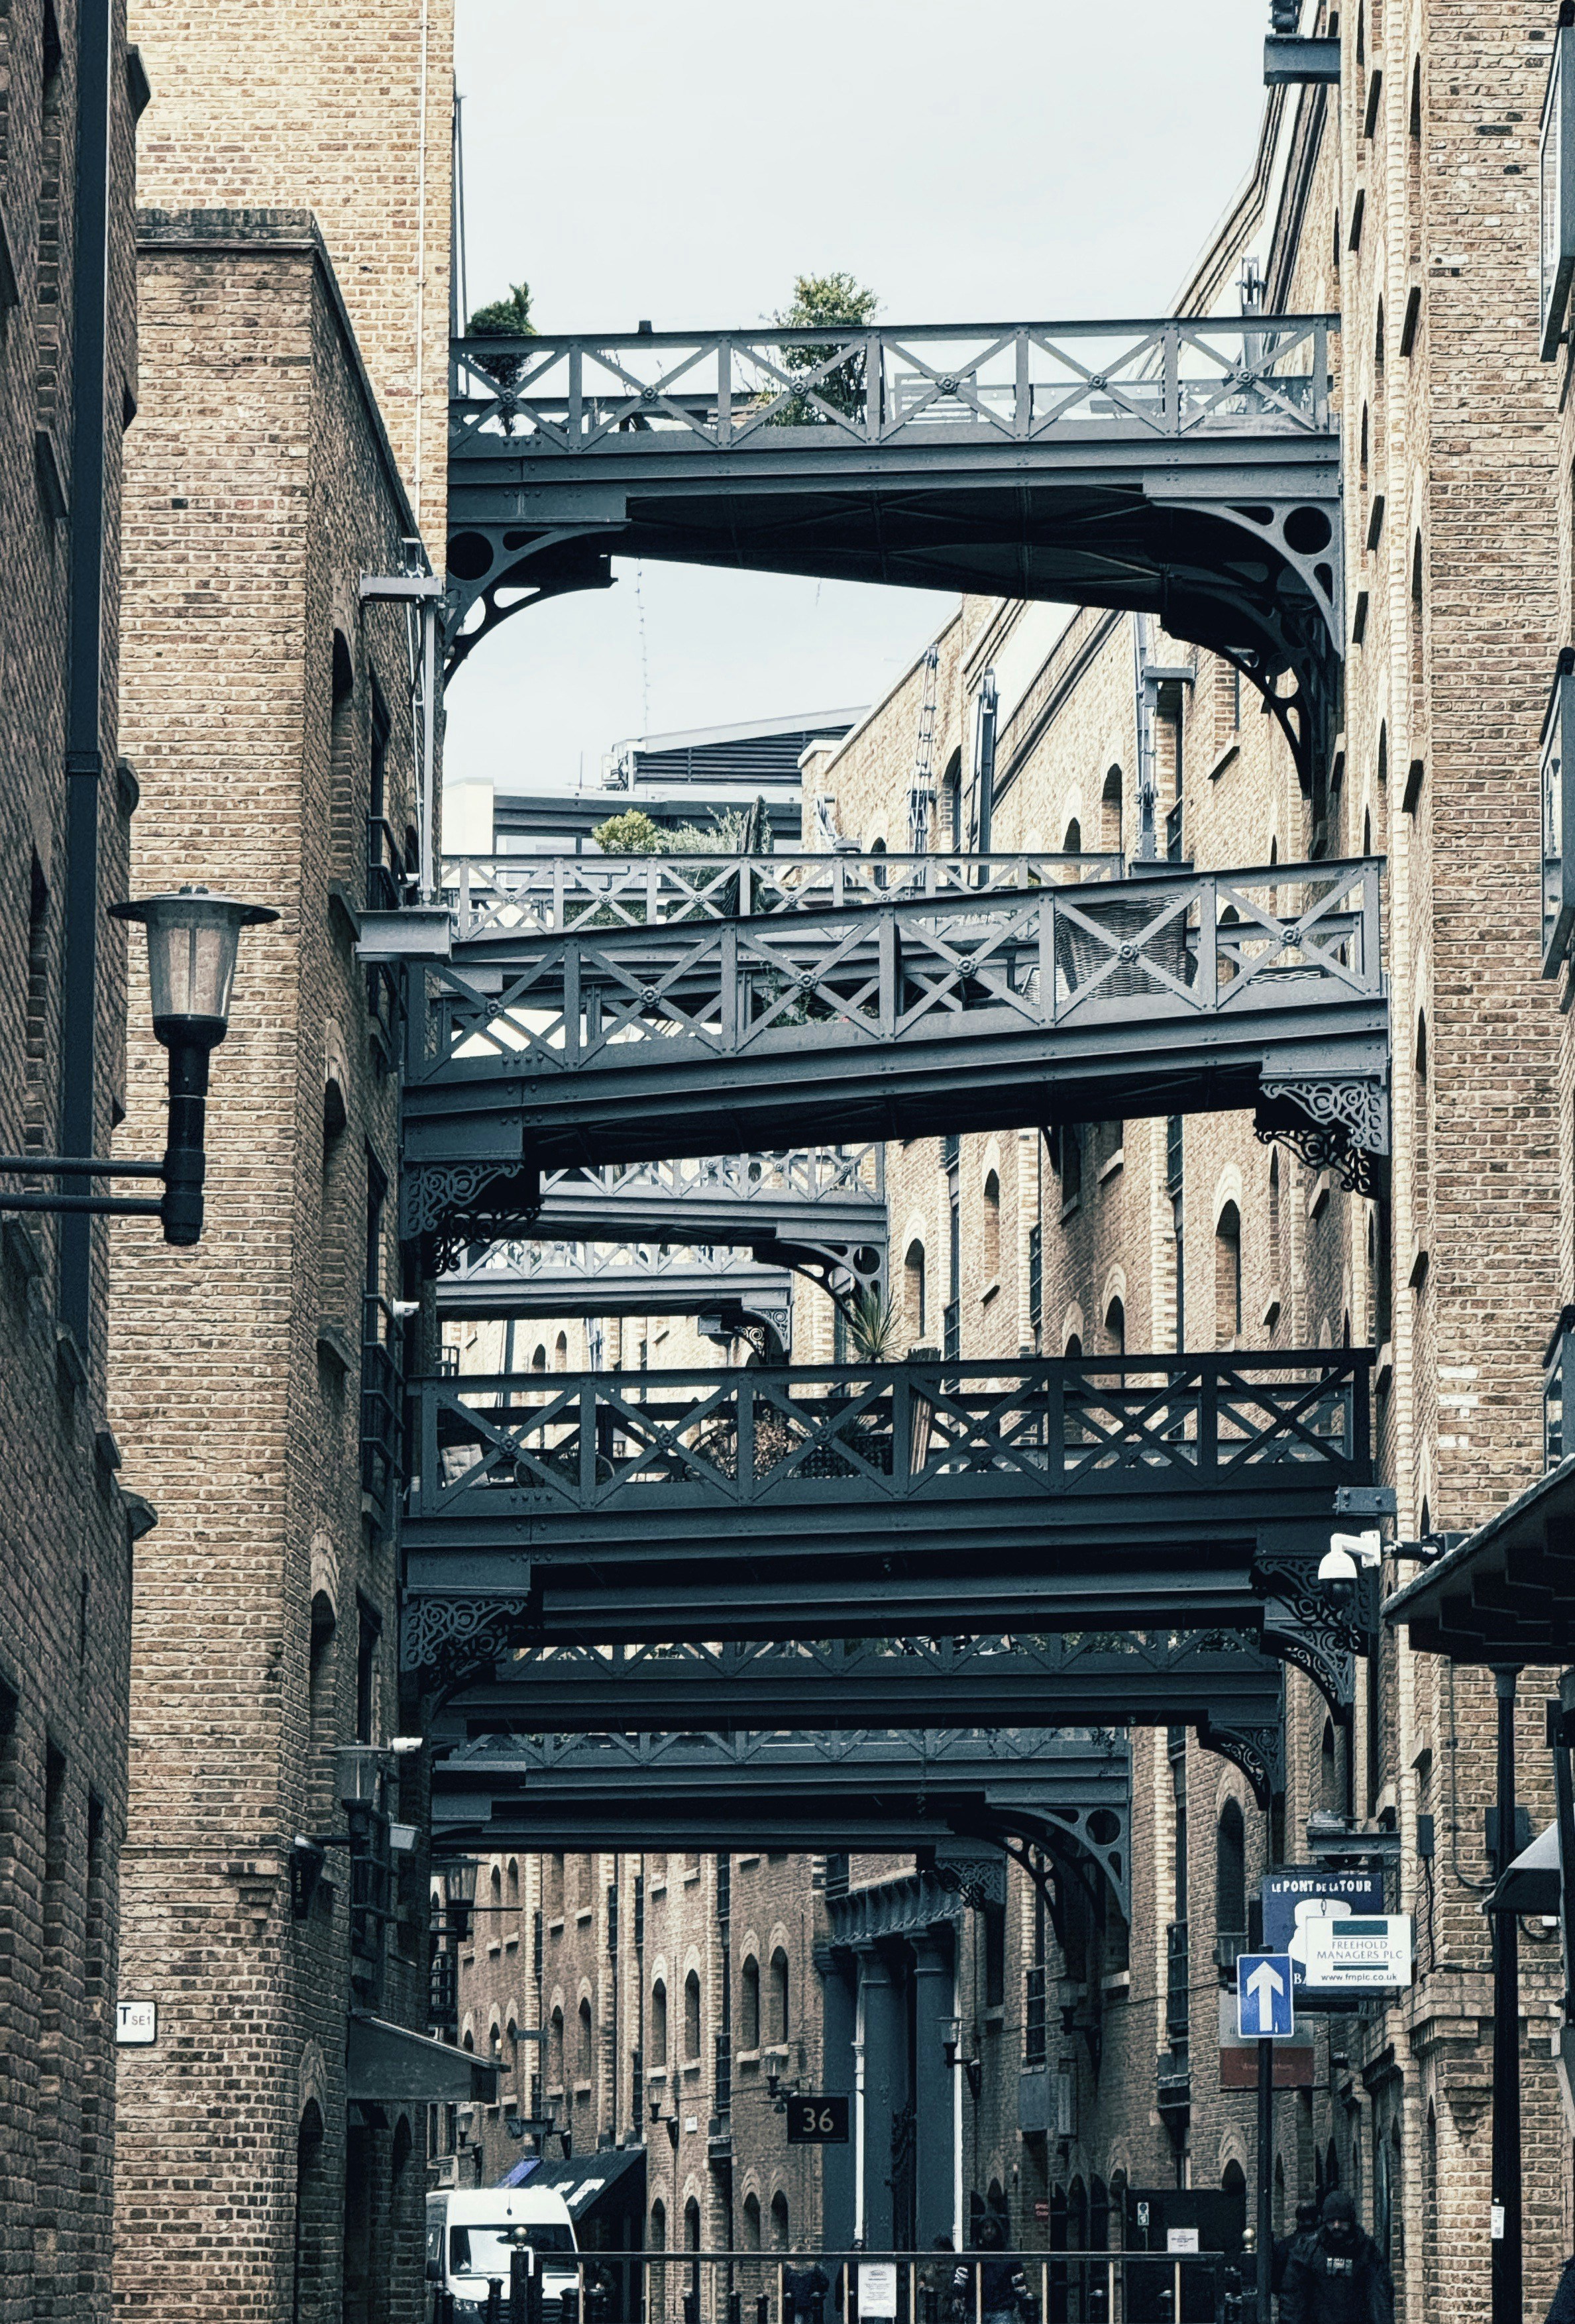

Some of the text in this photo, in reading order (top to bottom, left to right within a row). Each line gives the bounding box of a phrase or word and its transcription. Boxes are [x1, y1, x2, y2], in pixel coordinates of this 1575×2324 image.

[1271, 1880, 1372, 1893] LE PONT DE LA TOUR
[1332, 1941, 1387, 1950] FREEHOLD
[1317, 1950, 1403, 1960] MANAGERS PLC
[1321, 1973, 1397, 1982] www.fmplc.co.uk
[132, 2015, 150, 2026] SE1
[802, 2107, 834, 2132] 36
